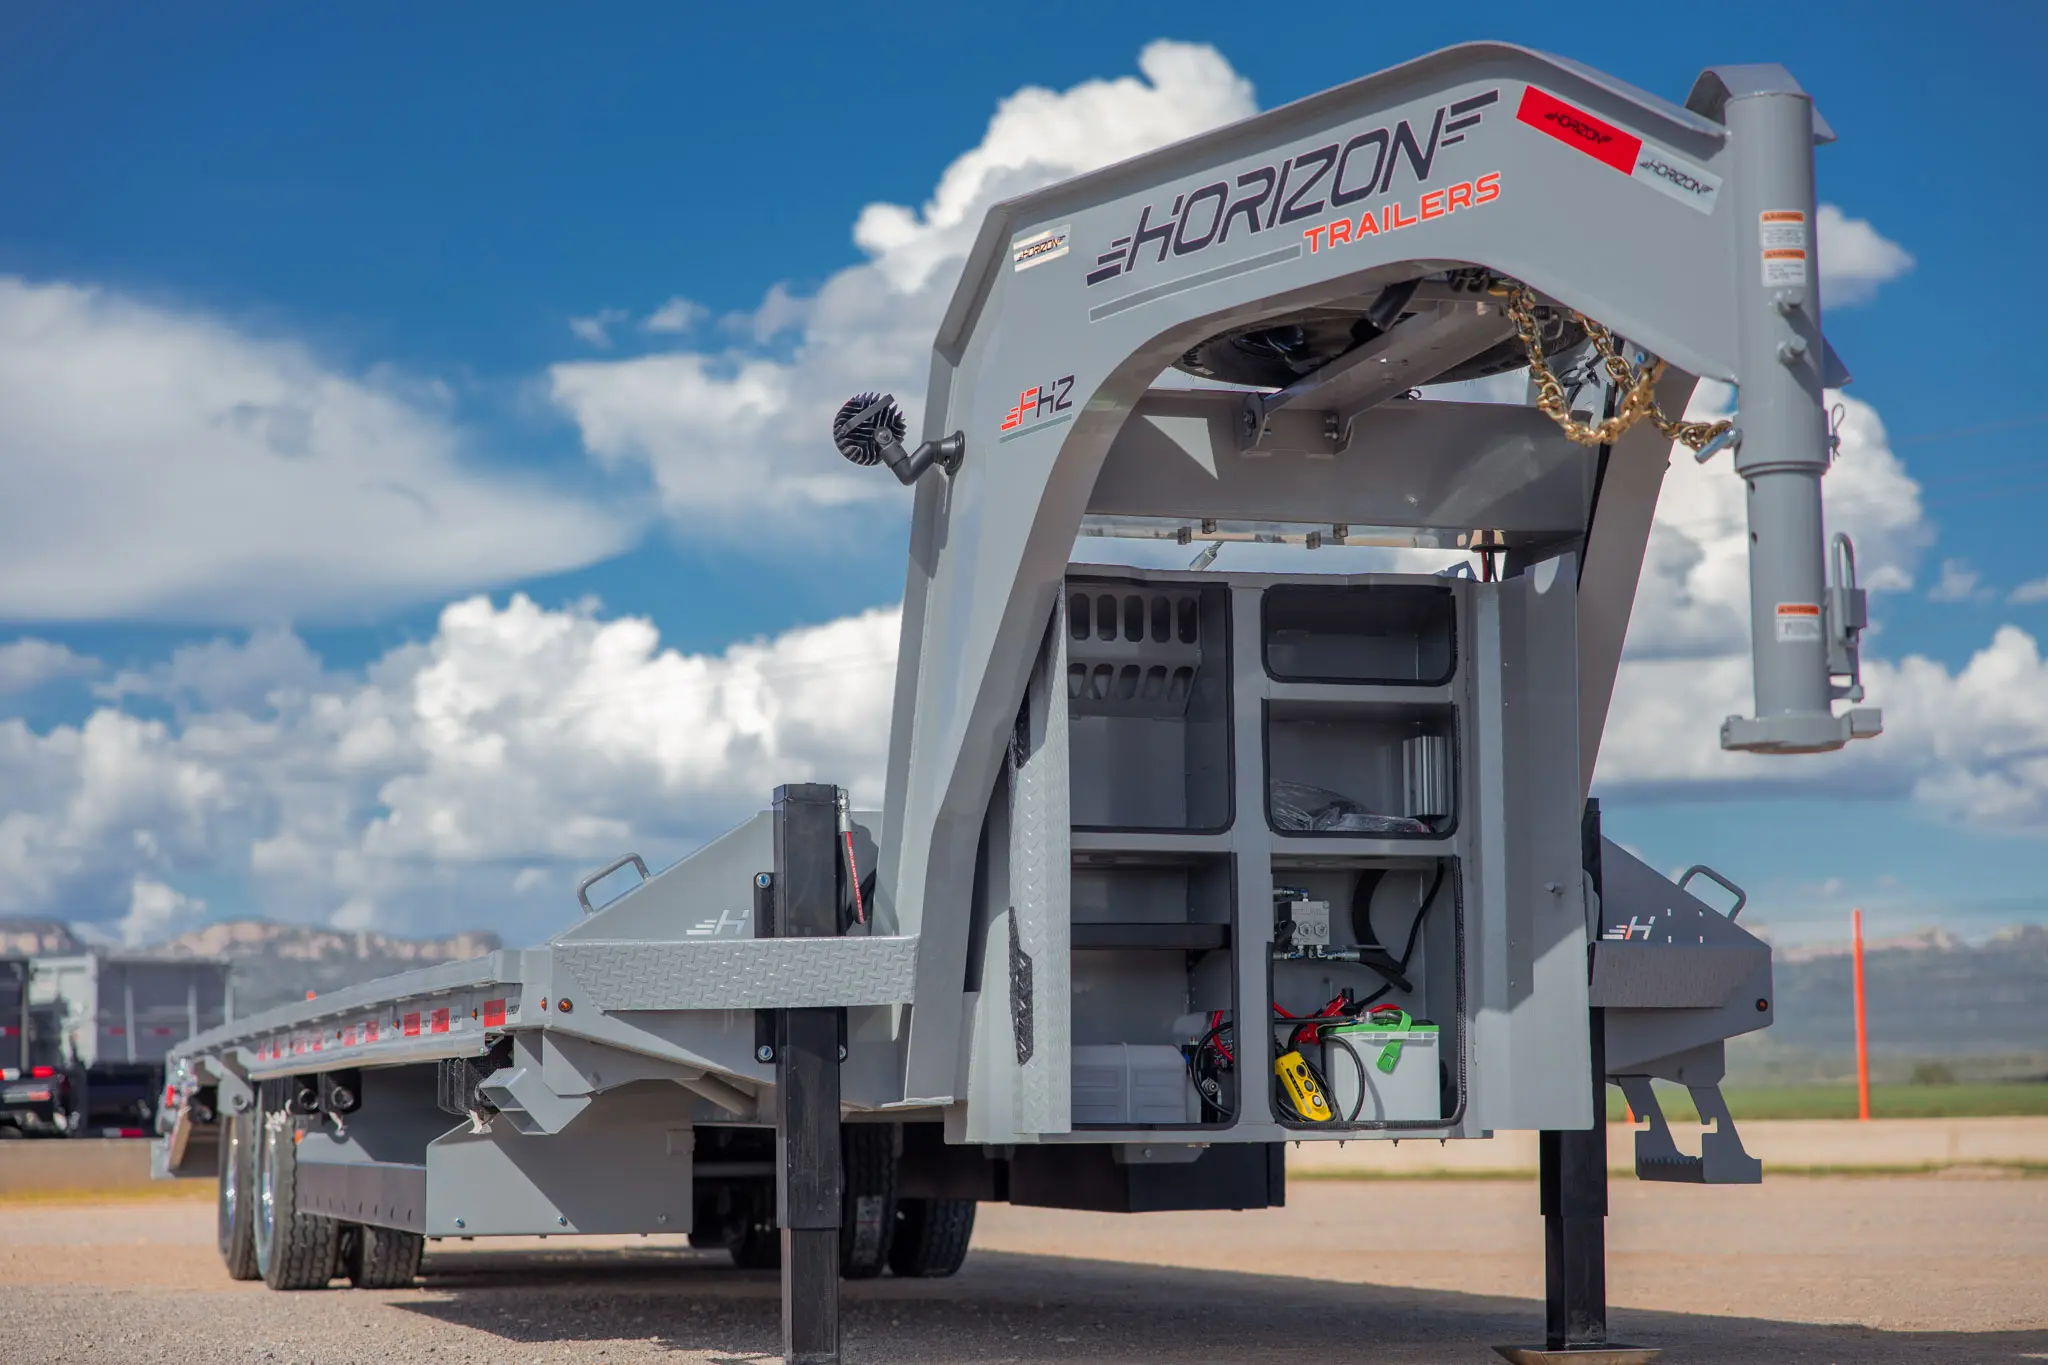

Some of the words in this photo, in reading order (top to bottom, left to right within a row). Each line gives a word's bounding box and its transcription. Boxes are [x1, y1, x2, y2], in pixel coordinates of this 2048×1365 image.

[1125, 106, 1447, 273] HORIZON
[1304, 172, 1501, 253] TRAILERS
[1644, 160, 1705, 195] HORIZON
